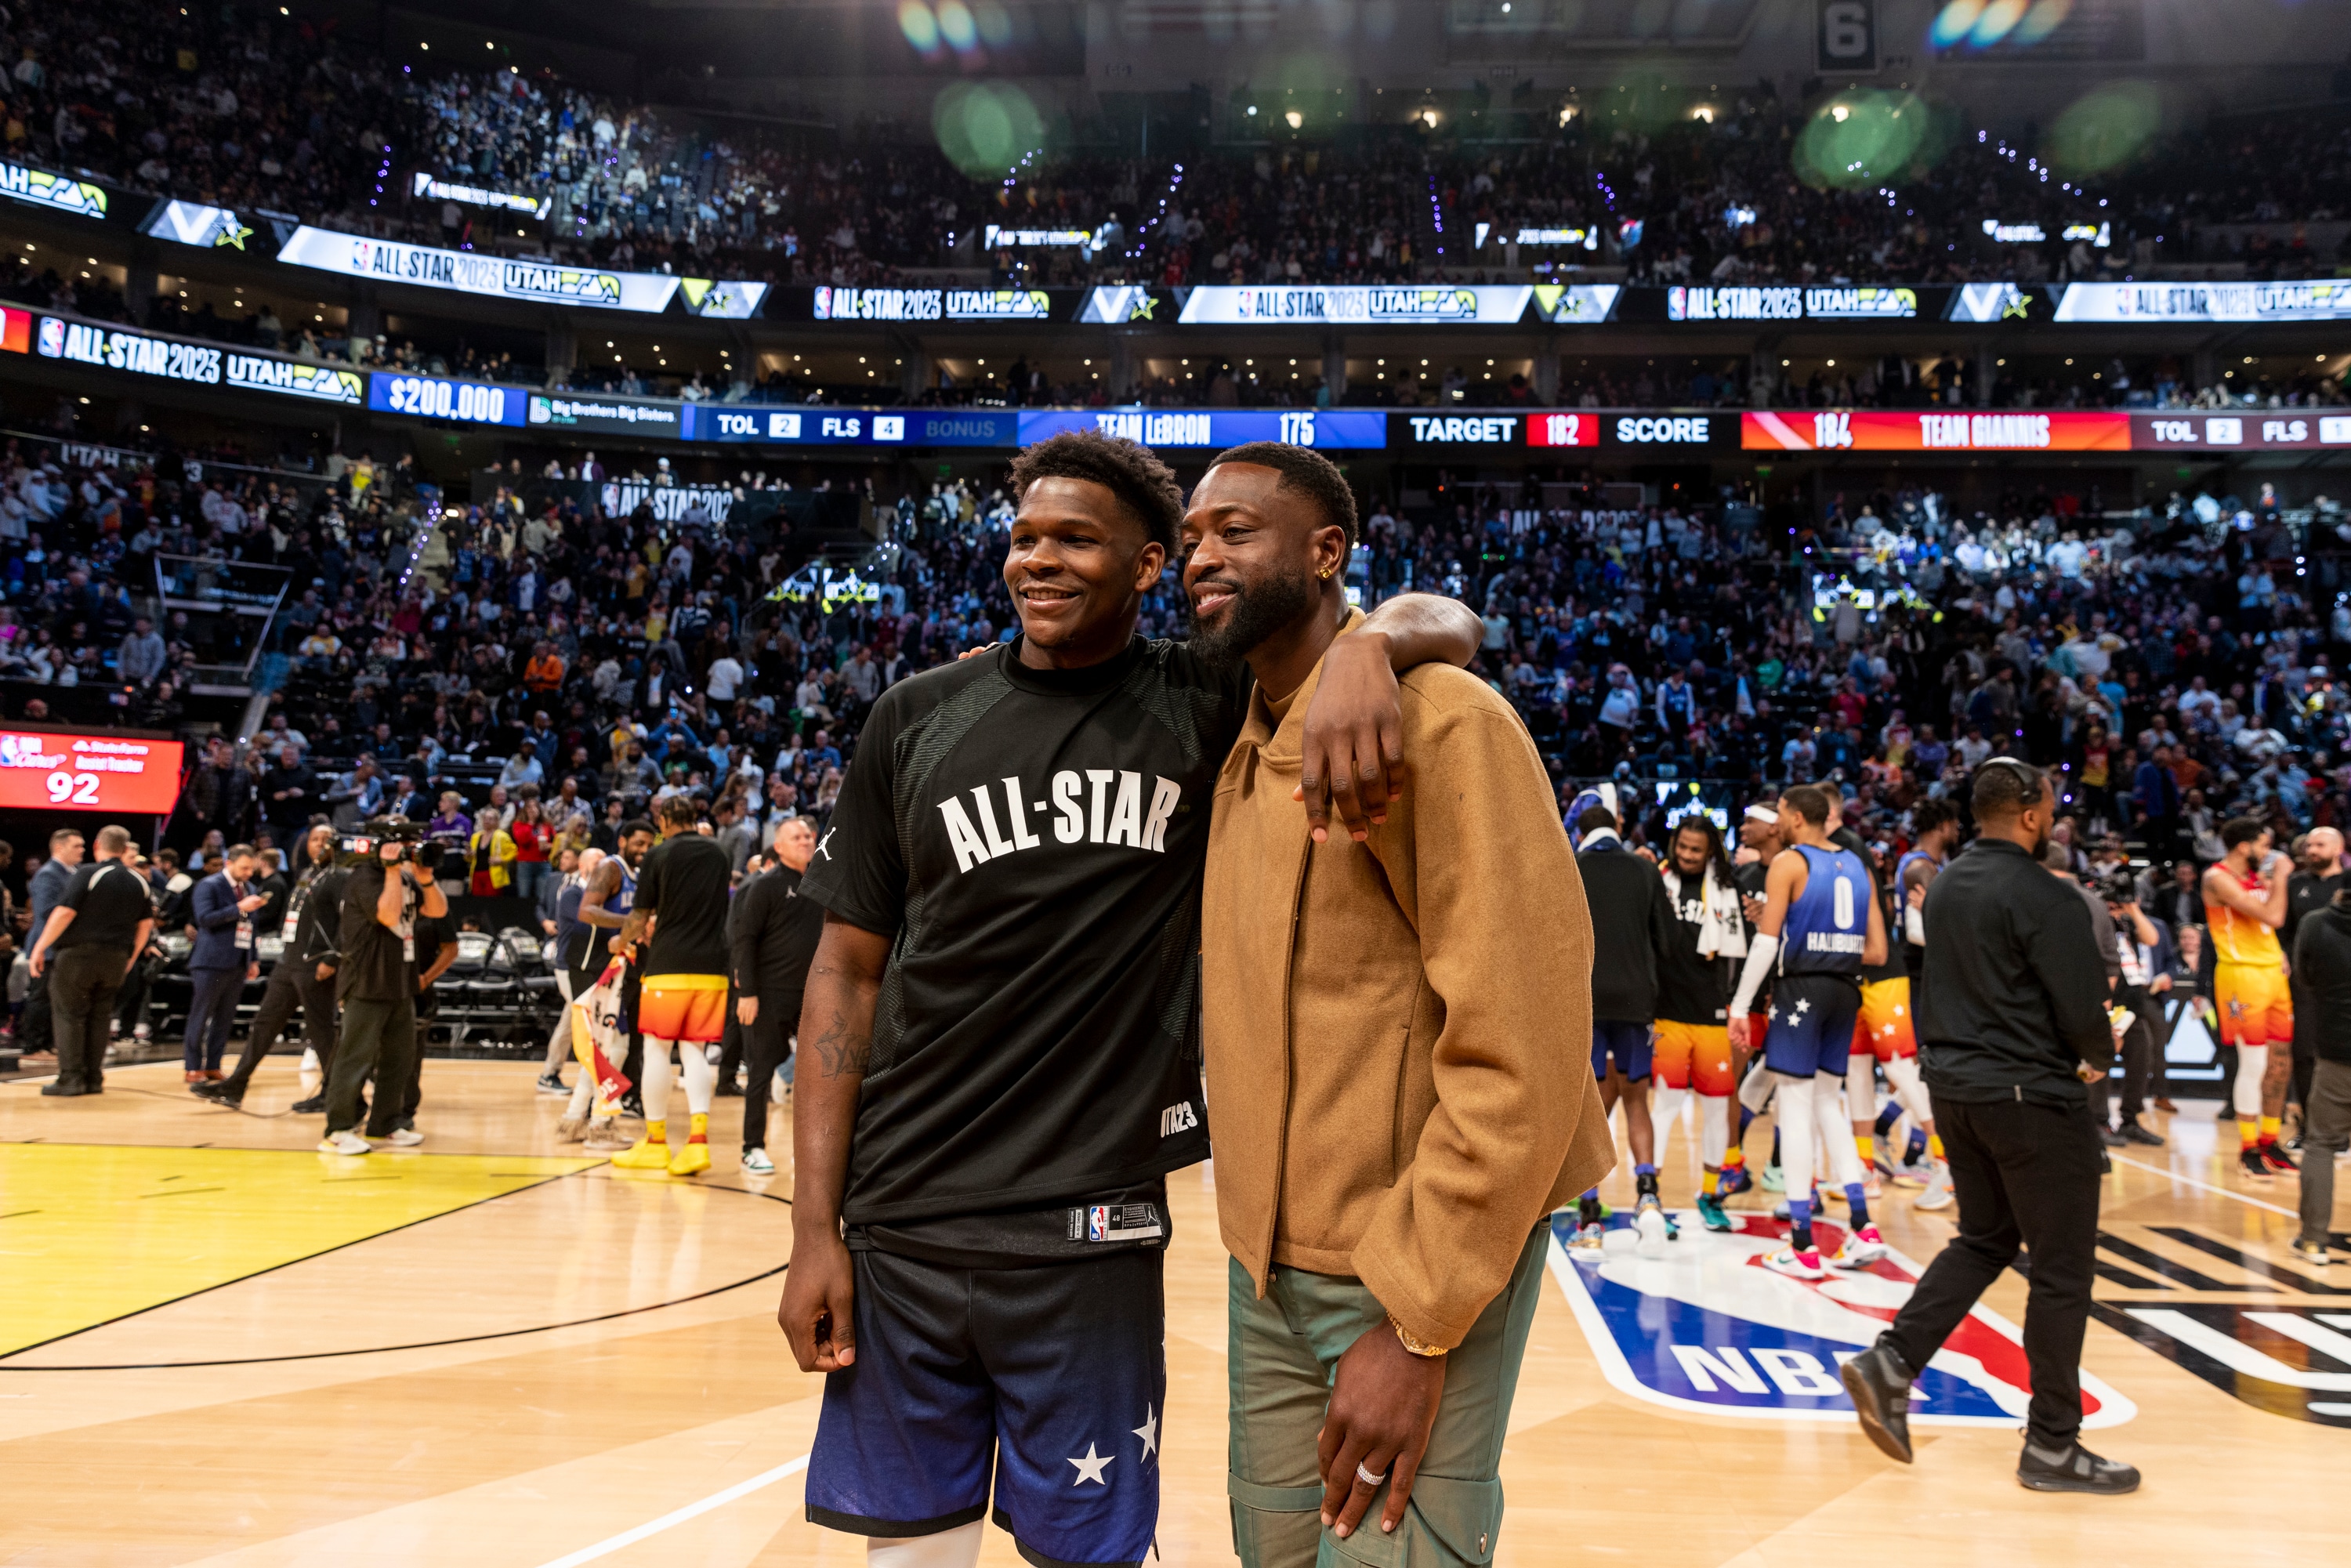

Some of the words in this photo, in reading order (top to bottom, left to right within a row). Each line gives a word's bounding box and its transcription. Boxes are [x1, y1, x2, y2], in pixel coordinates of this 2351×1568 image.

[1825, 2, 1868, 58] 6
[373, 245, 455, 284] ALL-STAR
[458, 257, 499, 290] 2023
[505, 264, 562, 292] UTAH
[904, 289, 942, 320] 2023
[946, 291, 995, 313] UTAH
[1255, 292, 1325, 317] ALL-STAR
[1328, 292, 1364, 317] 2023
[1370, 291, 1421, 313] UTAH
[1762, 288, 1802, 319] 2023
[1806, 288, 1859, 313] UTAH
[2257, 287, 2313, 310] UTAH
[168, 343, 221, 384] 2023
[226, 353, 294, 388] UTAH
[552, 400, 571, 417] Big
[618, 405, 637, 422] Big
[718, 415, 759, 435] TOL
[822, 418, 860, 437] FLS
[926, 420, 996, 438] BONUS
[1280, 412, 1315, 446] 175
[1410, 417, 1517, 442] TARGET
[1546, 415, 1579, 446] 182
[1617, 418, 1709, 442] SCORE
[1814, 412, 1853, 447] 184
[1920, 415, 1969, 447] TEAM
[2151, 421, 2198, 442] TOL
[2262, 420, 2308, 442] FLS
[701, 491, 734, 523] 202
[46, 772, 100, 805] 92
[936, 769, 1181, 874] ALL-STAR
[1834, 875, 1854, 930] 0
[1669, 1345, 1931, 1401] NB
